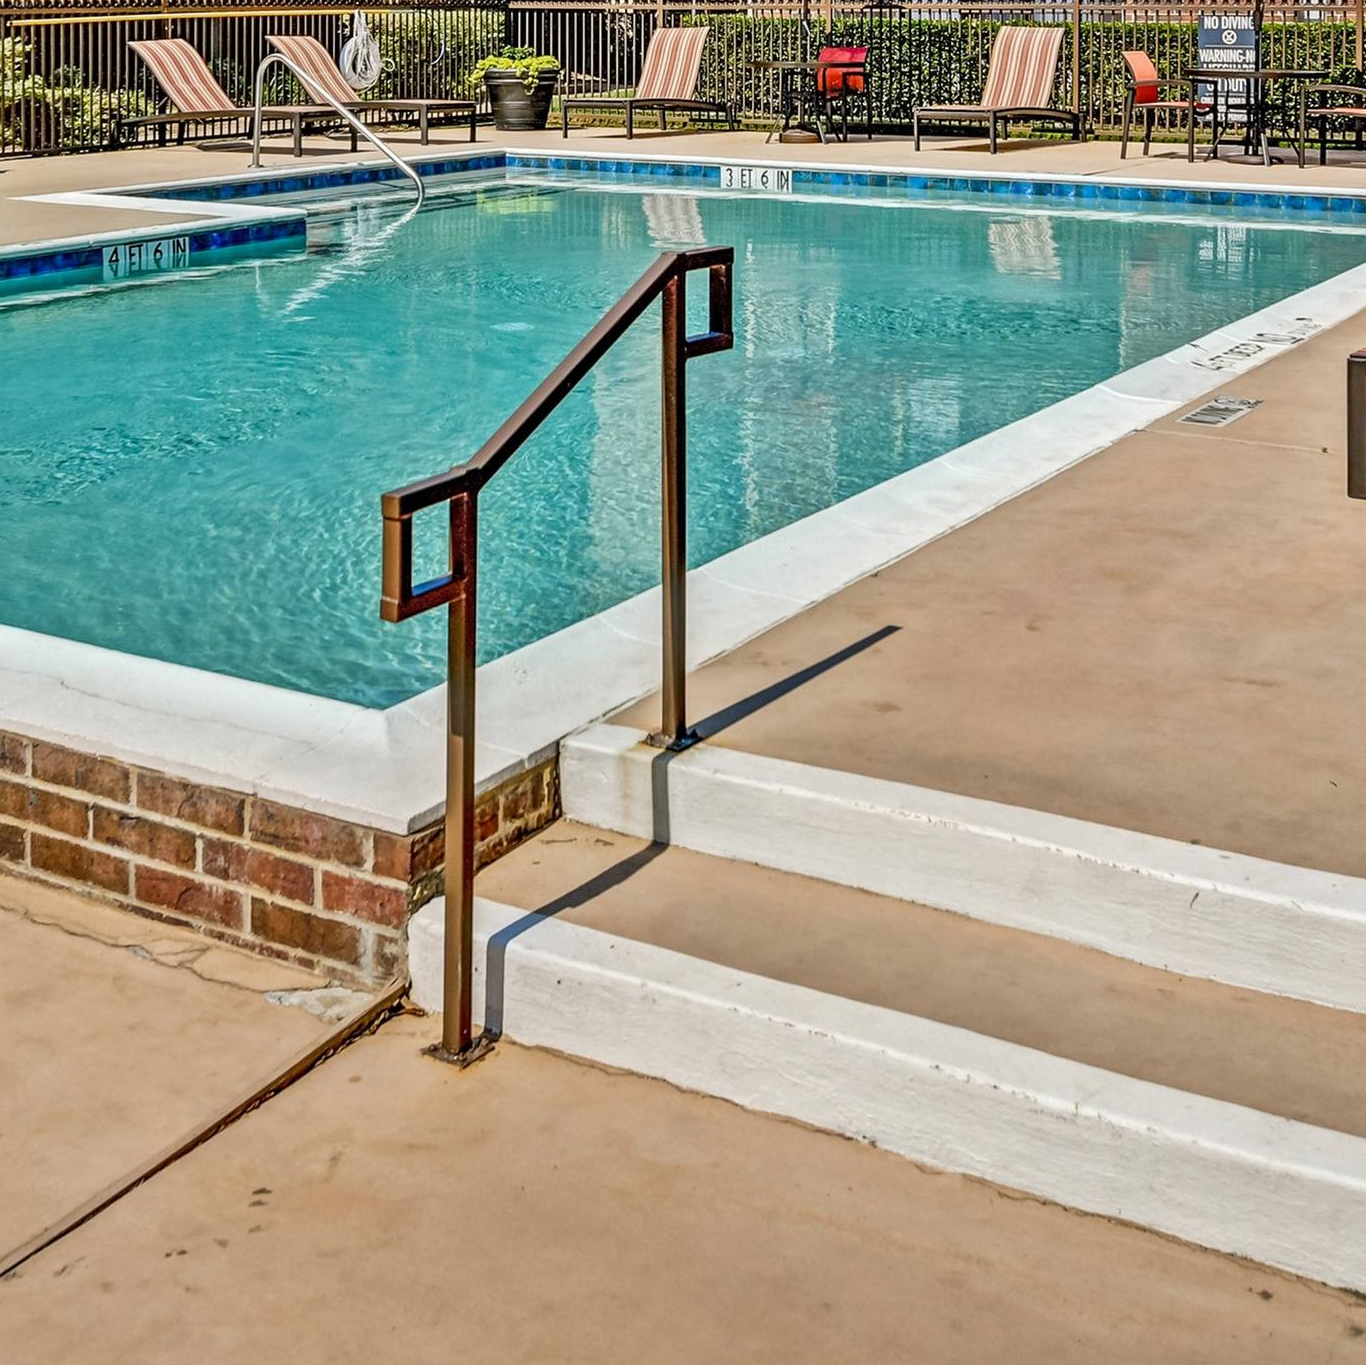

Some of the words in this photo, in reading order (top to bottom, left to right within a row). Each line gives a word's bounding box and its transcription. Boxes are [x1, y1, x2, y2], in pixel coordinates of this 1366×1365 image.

[1204, 16, 1219, 29] NO
[1221, 16, 1255, 29] DIVING
[1199, 49, 1255, 62] WARNING-N
[108, 246, 120, 263] 4
[128, 244, 144, 260] FT
[154, 242, 164, 259] 6
[172, 238, 186, 253] IN
